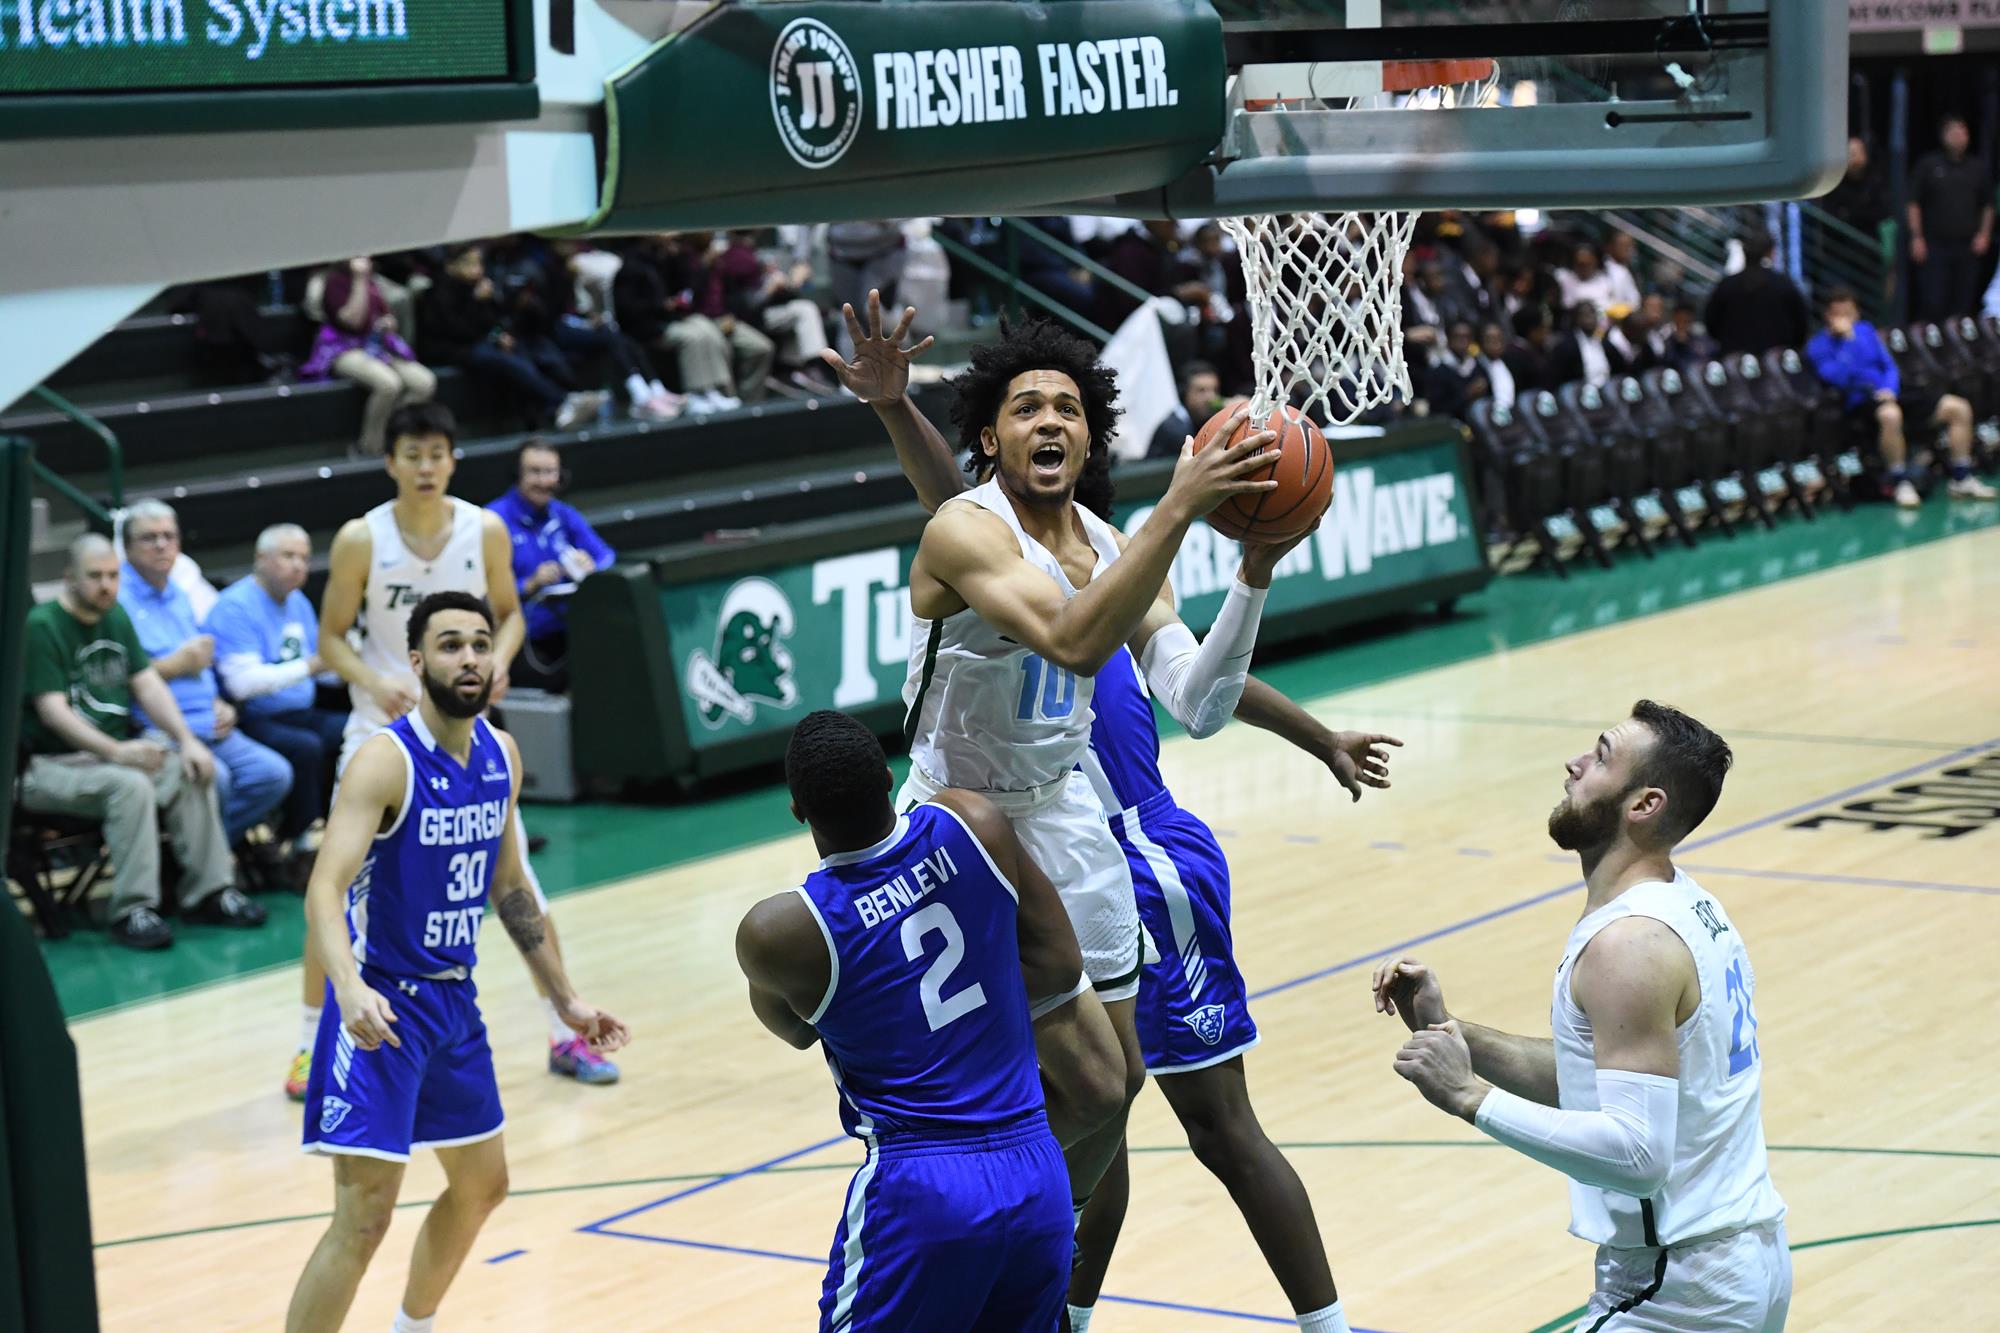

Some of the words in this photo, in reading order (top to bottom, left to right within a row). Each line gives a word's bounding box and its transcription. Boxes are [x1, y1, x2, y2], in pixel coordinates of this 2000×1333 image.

[795, 60, 836, 130] JJ
[873, 45, 1028, 131] FRESHER
[1036, 35, 1179, 117] FASTER.
[1016, 652, 1077, 721] 10
[446, 850, 488, 902] 30
[853, 846, 958, 930] BENLEVI
[900, 902, 988, 1033] 2
